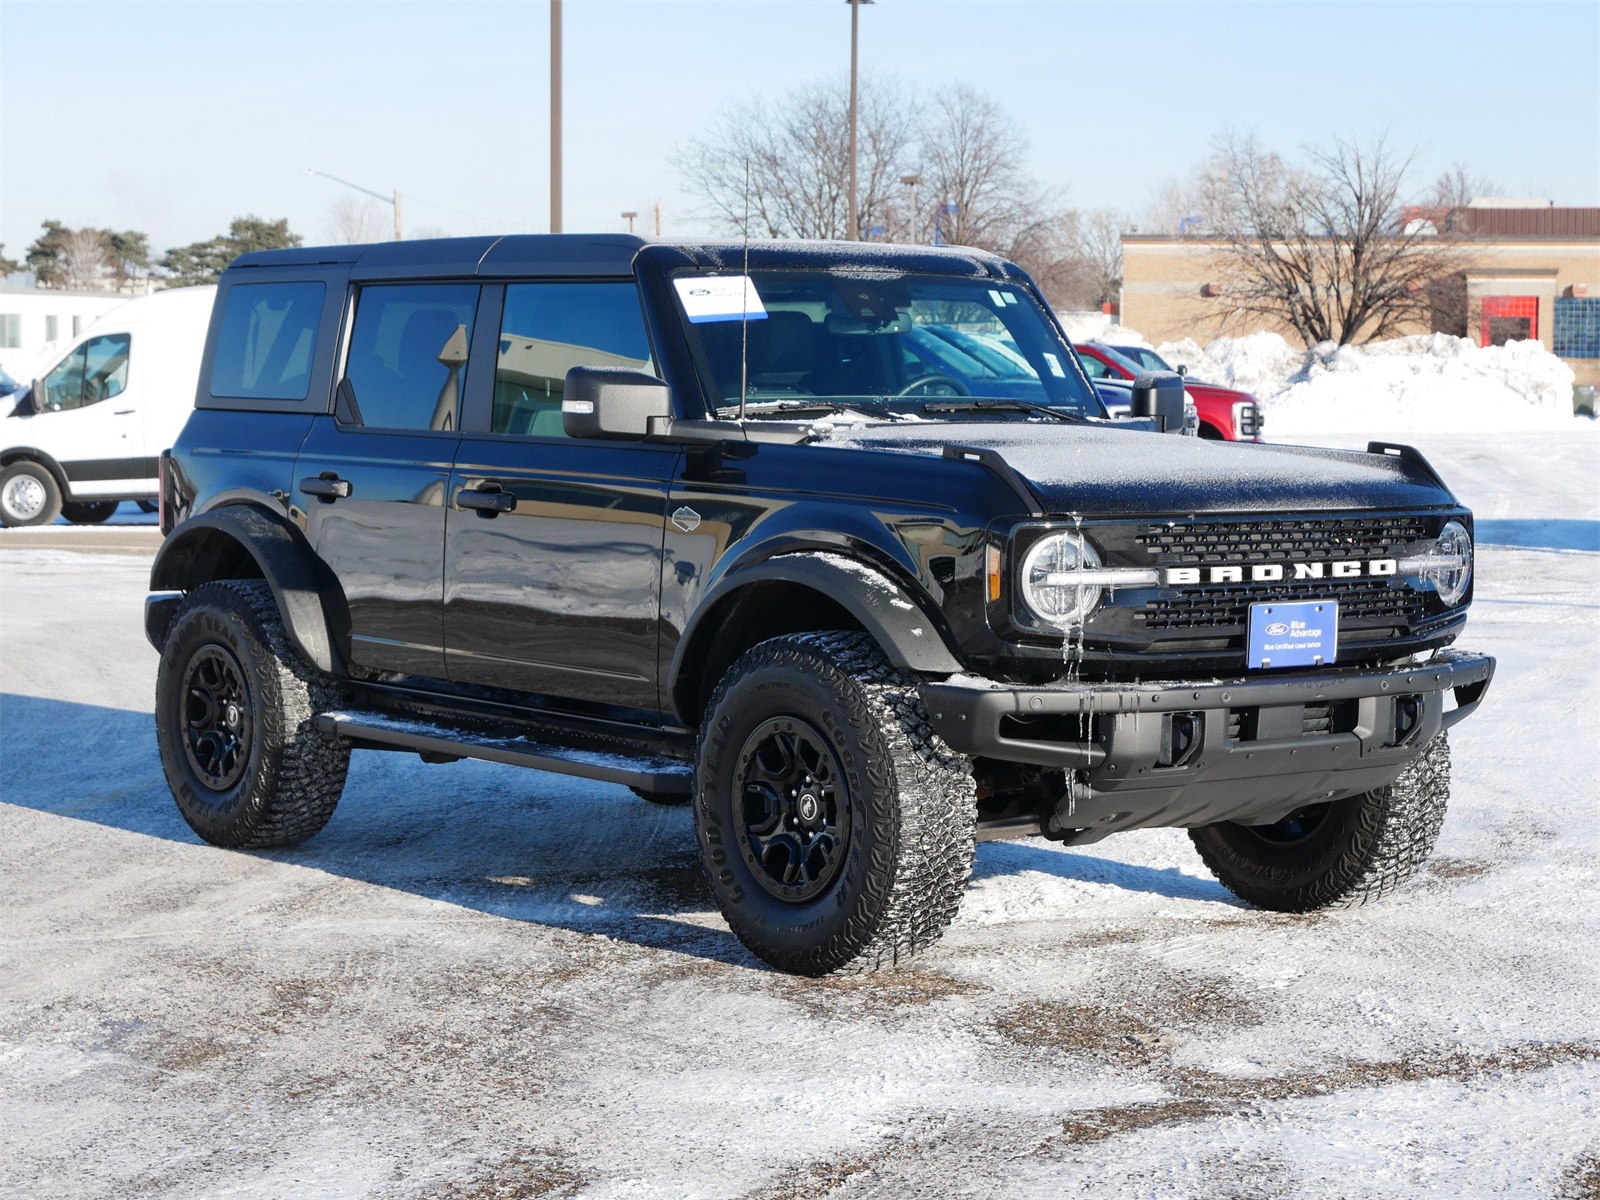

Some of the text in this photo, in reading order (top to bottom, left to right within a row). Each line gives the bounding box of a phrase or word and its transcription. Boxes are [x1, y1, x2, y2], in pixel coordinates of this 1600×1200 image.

[1166, 559, 1397, 584] BRONCO
[1267, 623, 1287, 634] Ford
[1290, 620, 1306, 629] Blue
[1290, 629, 1322, 638] Advantage
